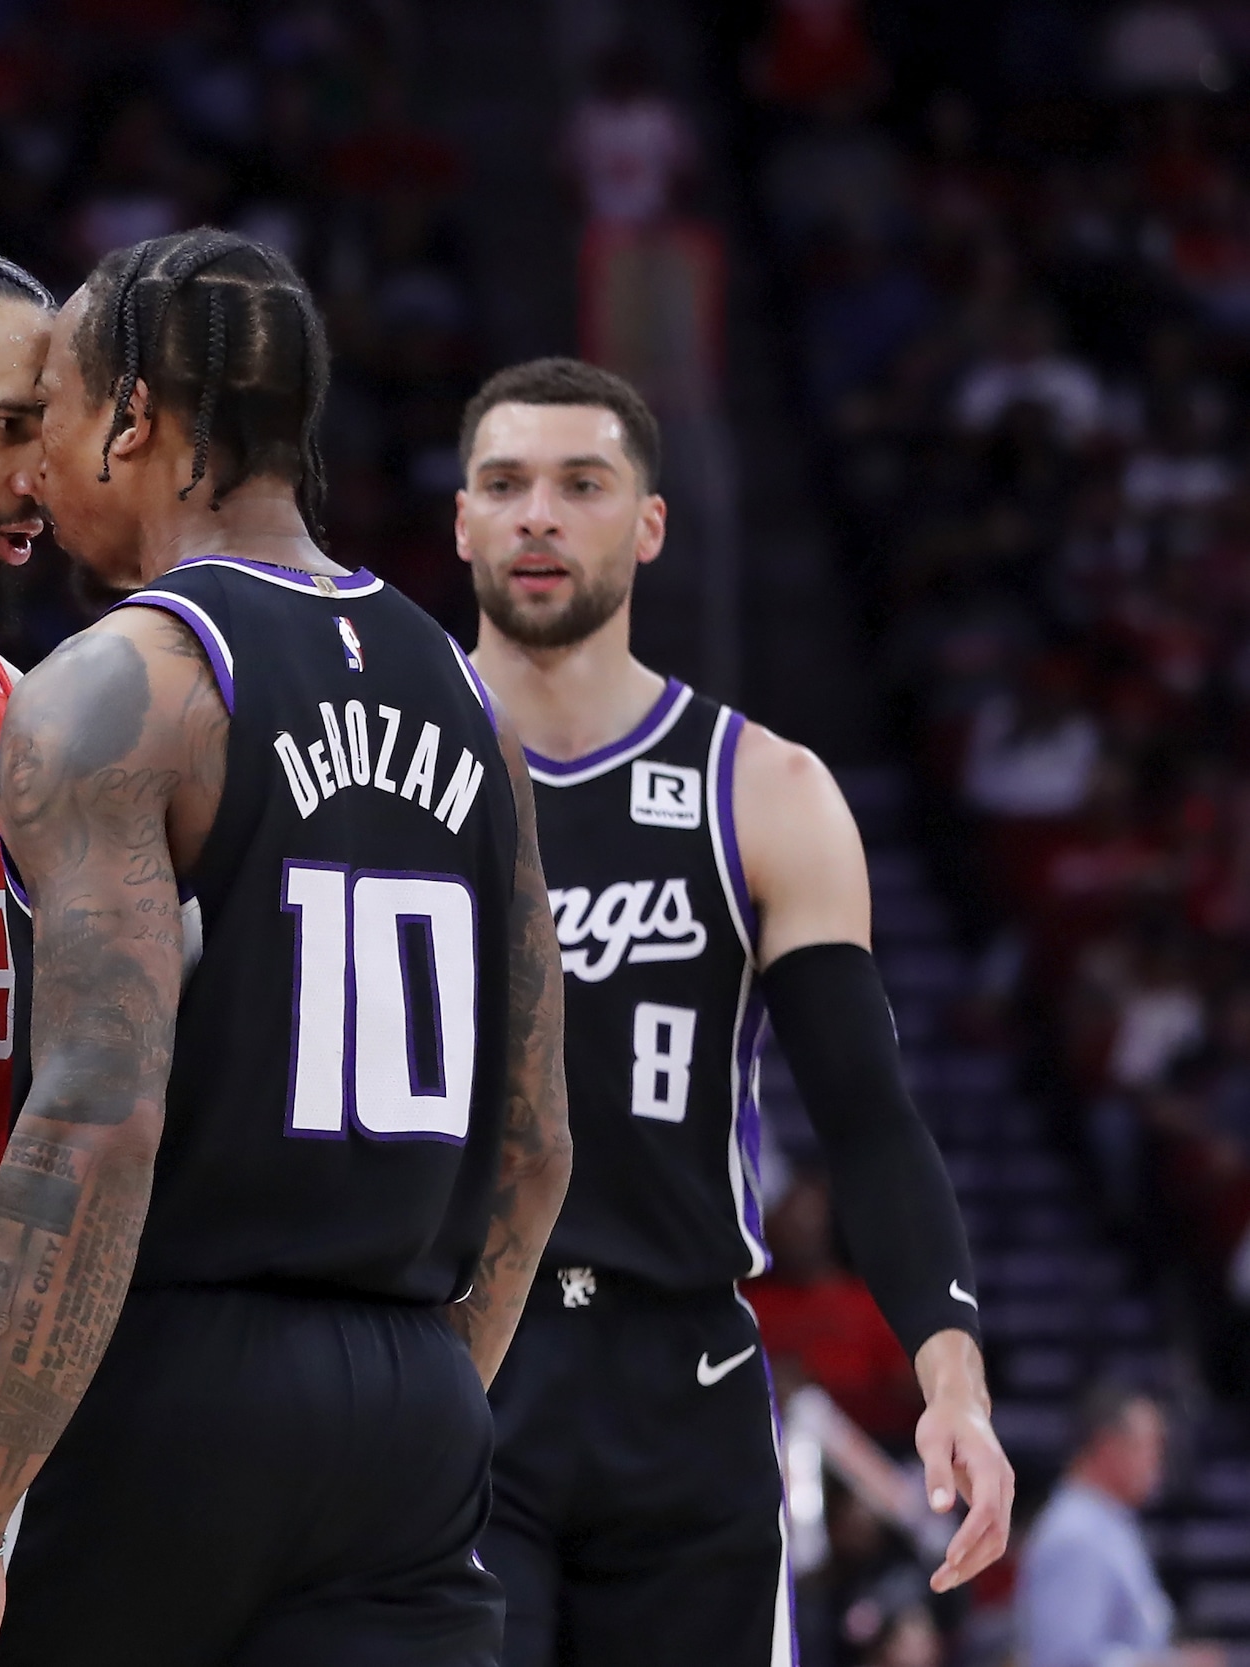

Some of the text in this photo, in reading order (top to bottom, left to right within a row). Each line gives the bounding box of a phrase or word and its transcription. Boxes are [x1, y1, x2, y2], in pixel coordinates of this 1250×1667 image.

[272, 699, 485, 835] DeROZAN
[548, 878, 708, 983] ngs
[280, 857, 479, 1147] 10
[631, 1001, 697, 1124] 8
[10, 1237, 63, 1365] BLUE CITY
